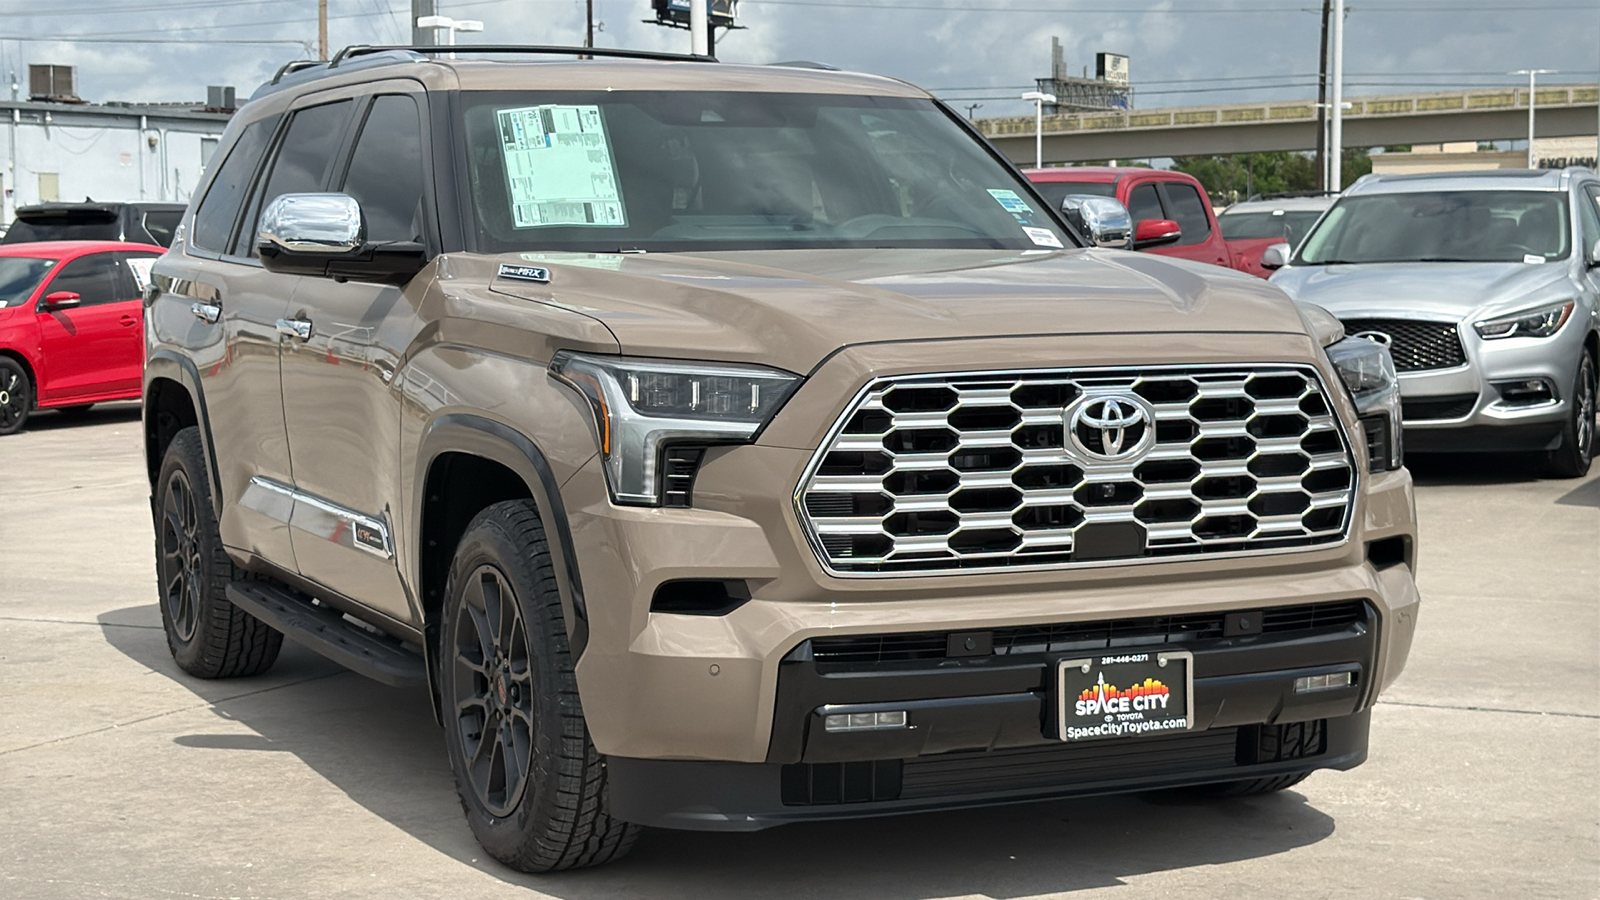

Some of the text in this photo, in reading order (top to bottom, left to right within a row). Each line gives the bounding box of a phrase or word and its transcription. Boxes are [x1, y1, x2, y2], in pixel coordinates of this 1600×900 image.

[1075, 690, 1170, 716] SPACE CITY
[1116, 712, 1144, 722] TOYOTA
[1067, 718, 1187, 739] SpaceCityToyota.com
